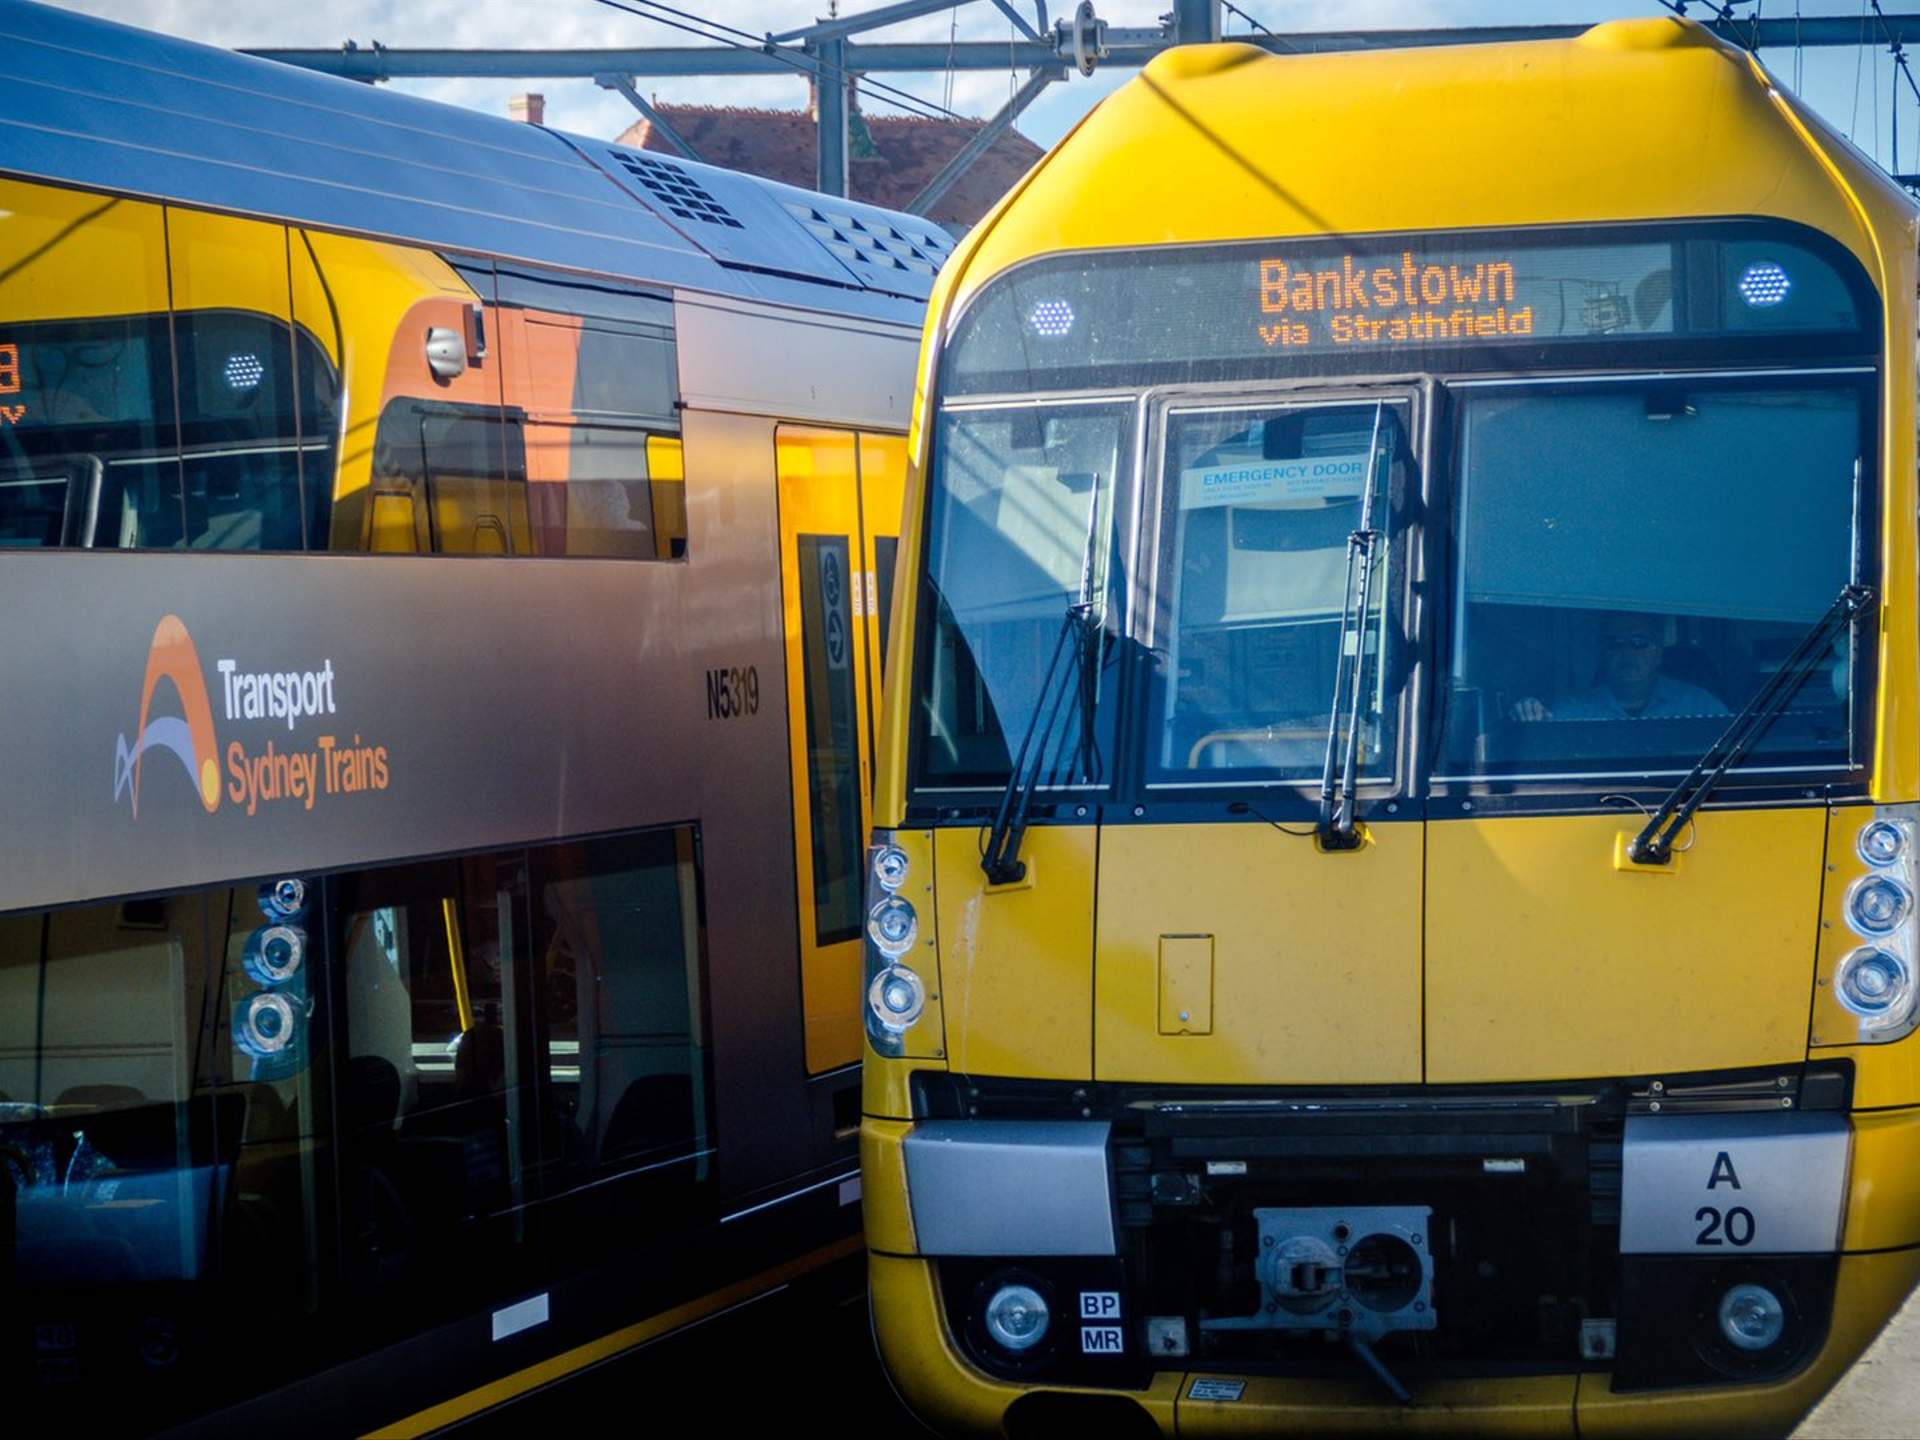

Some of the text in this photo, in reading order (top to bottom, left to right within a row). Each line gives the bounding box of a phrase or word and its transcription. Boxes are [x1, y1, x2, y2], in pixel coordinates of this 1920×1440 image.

[1259, 251, 1515, 314] Bankstown
[1257, 306, 1534, 346] via Strathfield
[1203, 465, 1308, 486] EMERGENCY
[1313, 462, 1363, 477] DOOR
[217, 659, 336, 731] Transport
[706, 666, 760, 721] N5319
[227, 733, 390, 816] Sydney Trains
[1706, 1151, 1742, 1190] A
[1695, 1206, 1756, 1247] 20
[1083, 1295, 1117, 1316] BP
[1084, 1330, 1121, 1350] MR
